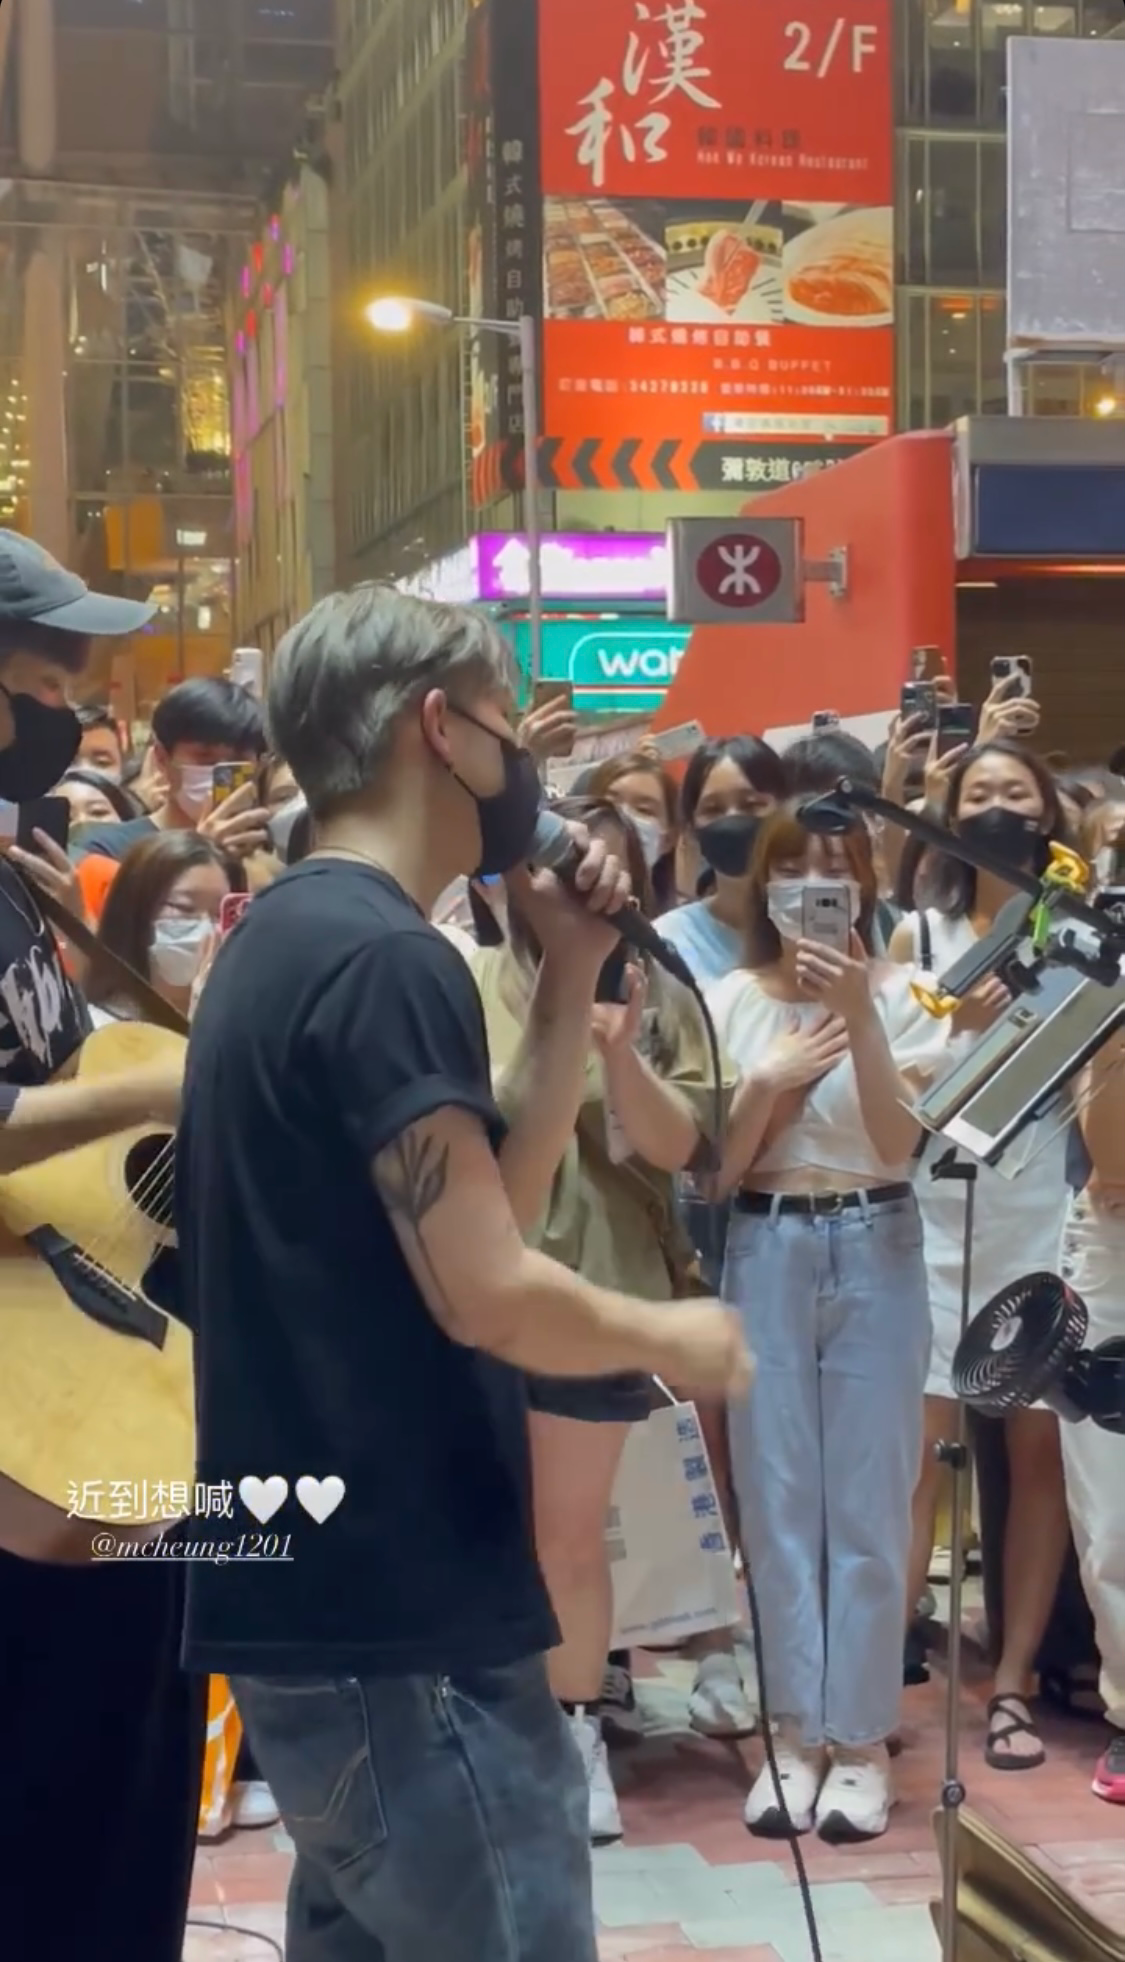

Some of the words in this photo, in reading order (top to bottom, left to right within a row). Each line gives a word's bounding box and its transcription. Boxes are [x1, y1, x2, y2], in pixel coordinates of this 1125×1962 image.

[783, 18, 878, 78] 2/F
[749, 152, 793, 167] Korean
[799, 153, 869, 170] Restaurant
[768, 359, 831, 373] BUFFET
